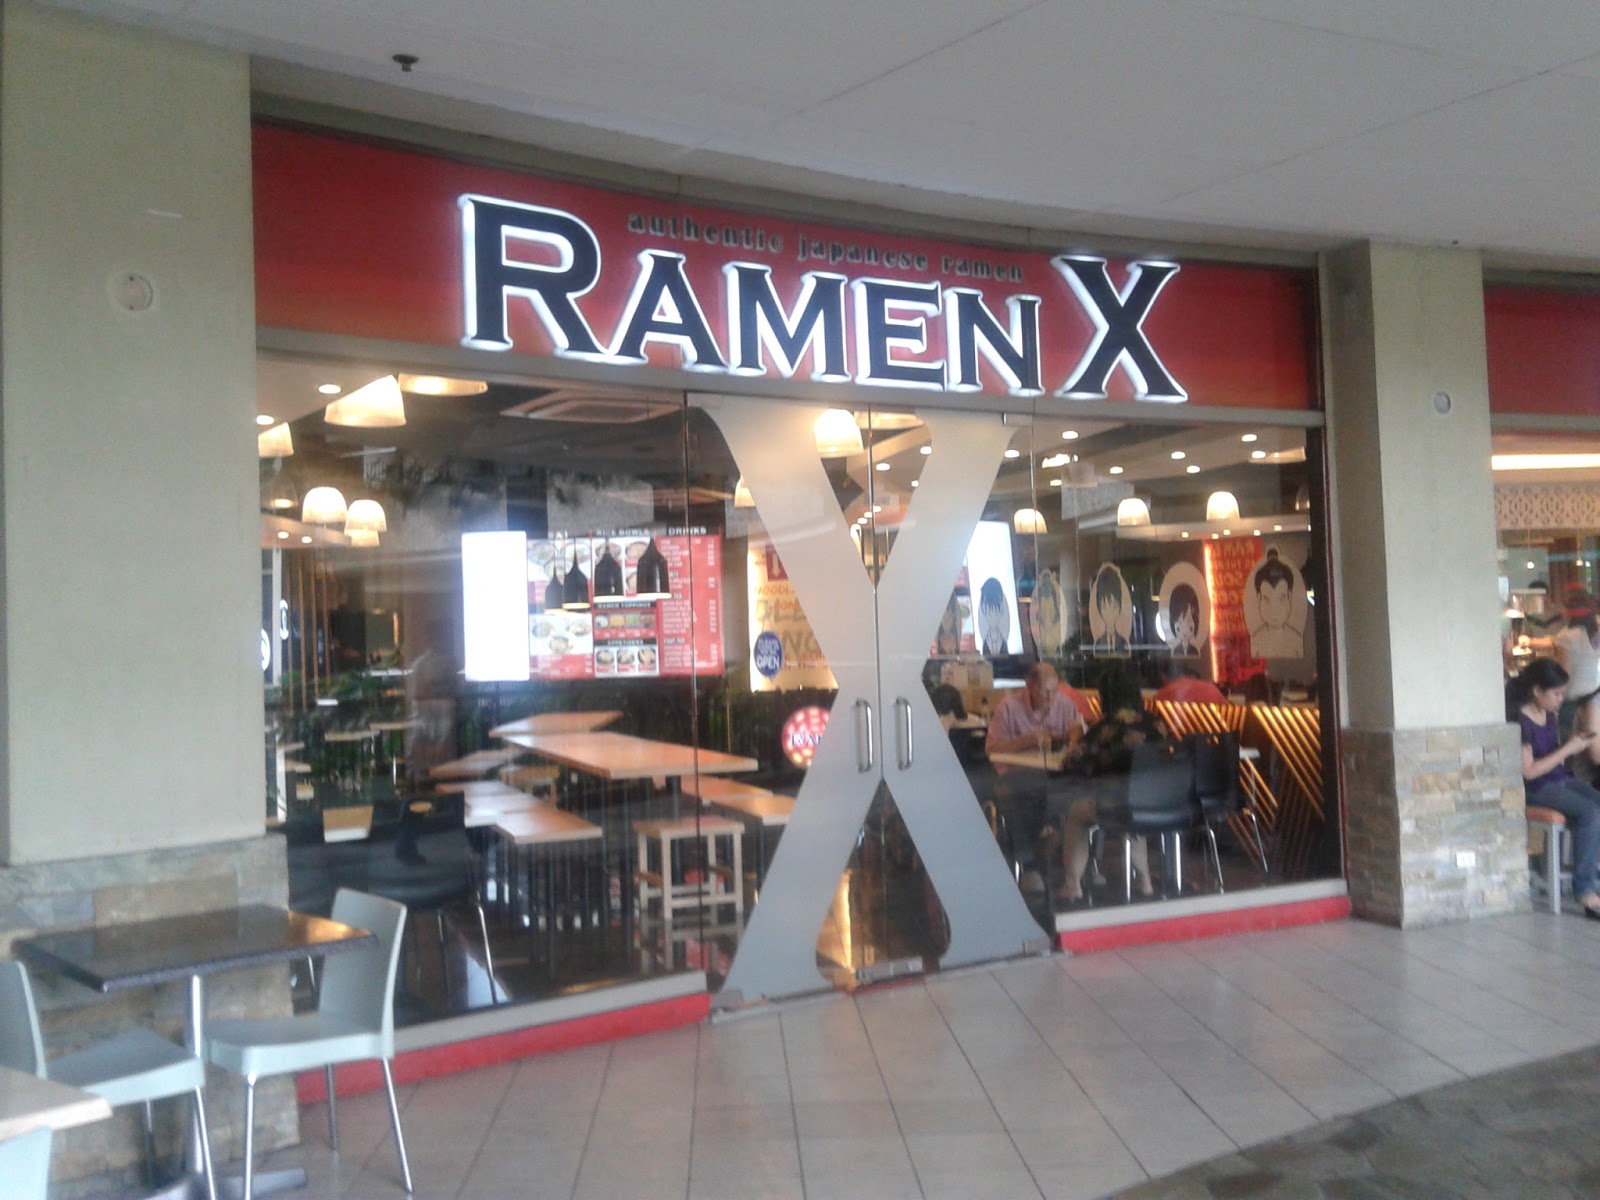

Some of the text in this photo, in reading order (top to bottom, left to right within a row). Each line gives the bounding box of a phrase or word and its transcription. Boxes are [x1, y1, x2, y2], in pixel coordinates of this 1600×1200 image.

[627, 212, 1024, 284] authentic japanese ramen
[457, 192, 1188, 402] RAMEN X
[757, 656, 780, 669] OPEN
